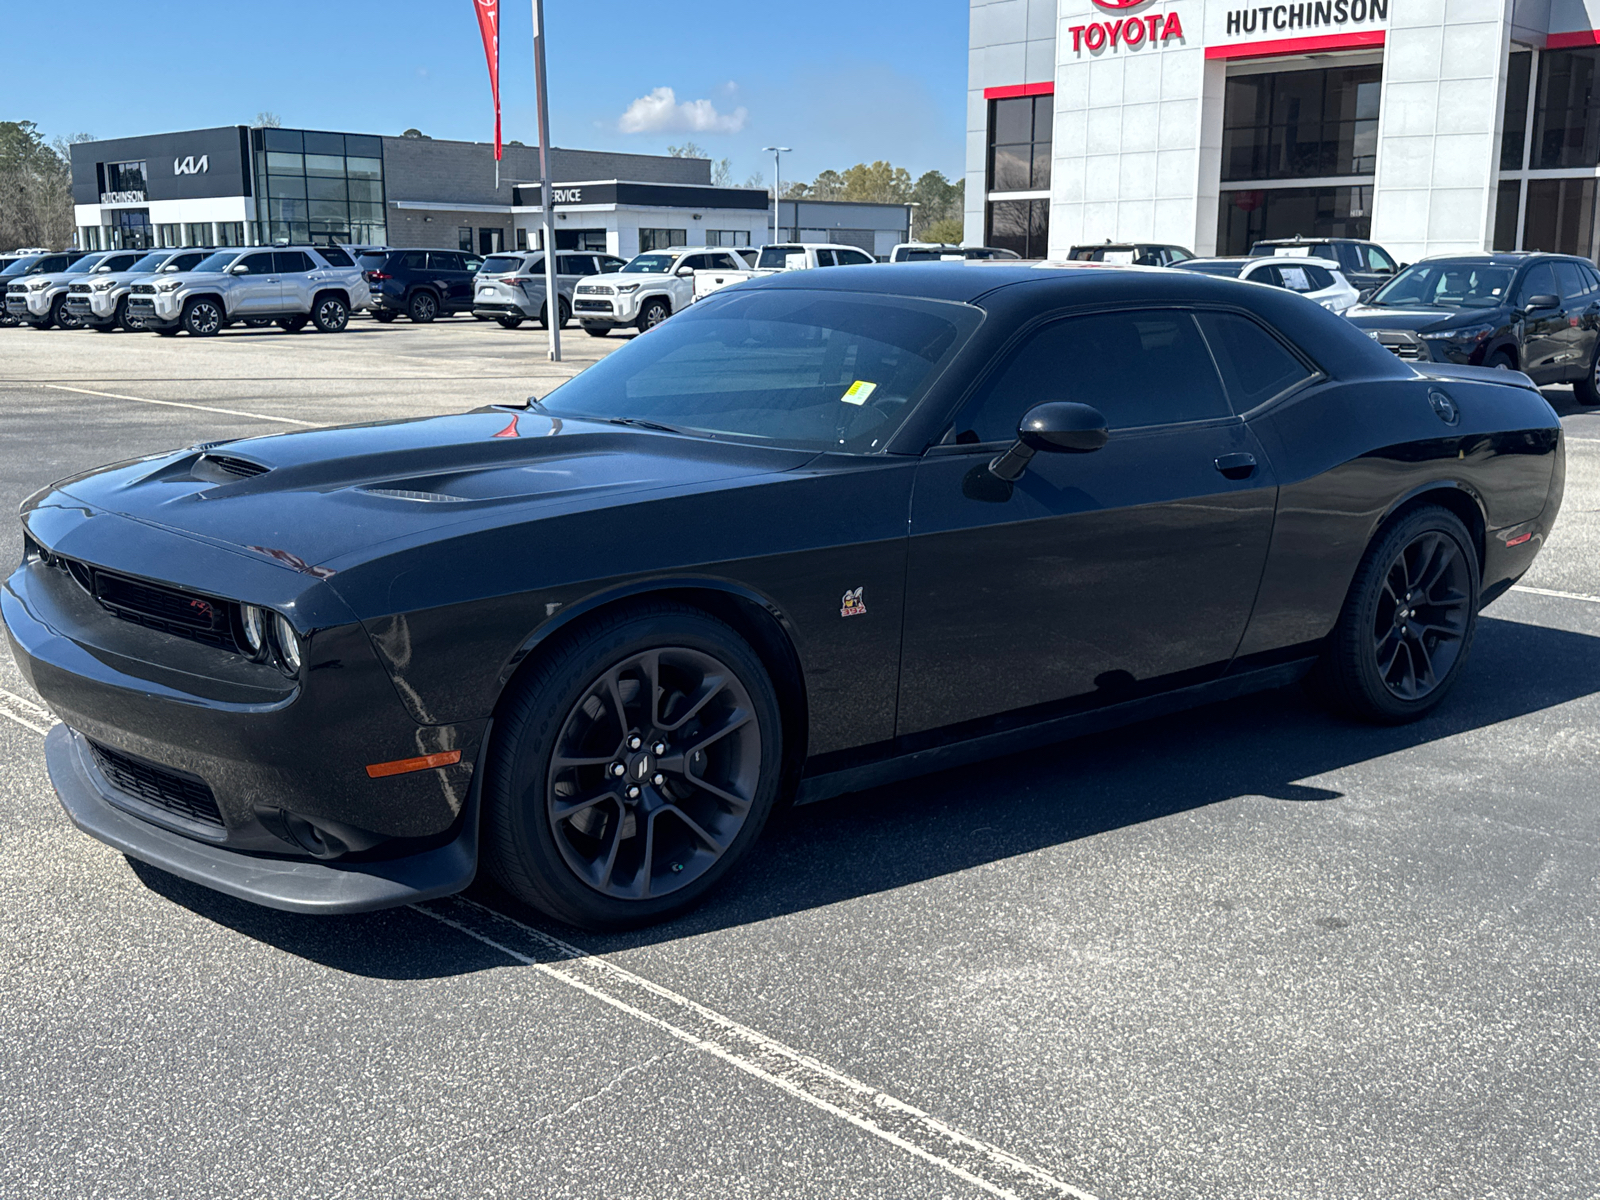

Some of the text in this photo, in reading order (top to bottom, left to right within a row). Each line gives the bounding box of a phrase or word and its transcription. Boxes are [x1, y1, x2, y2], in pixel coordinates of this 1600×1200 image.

[1226, 0, 1388, 34] HUTCHINSON
[1068, 12, 1183, 51] TOYOTA
[174, 155, 208, 175] KIA
[101, 191, 144, 204] HUTCHINSON
